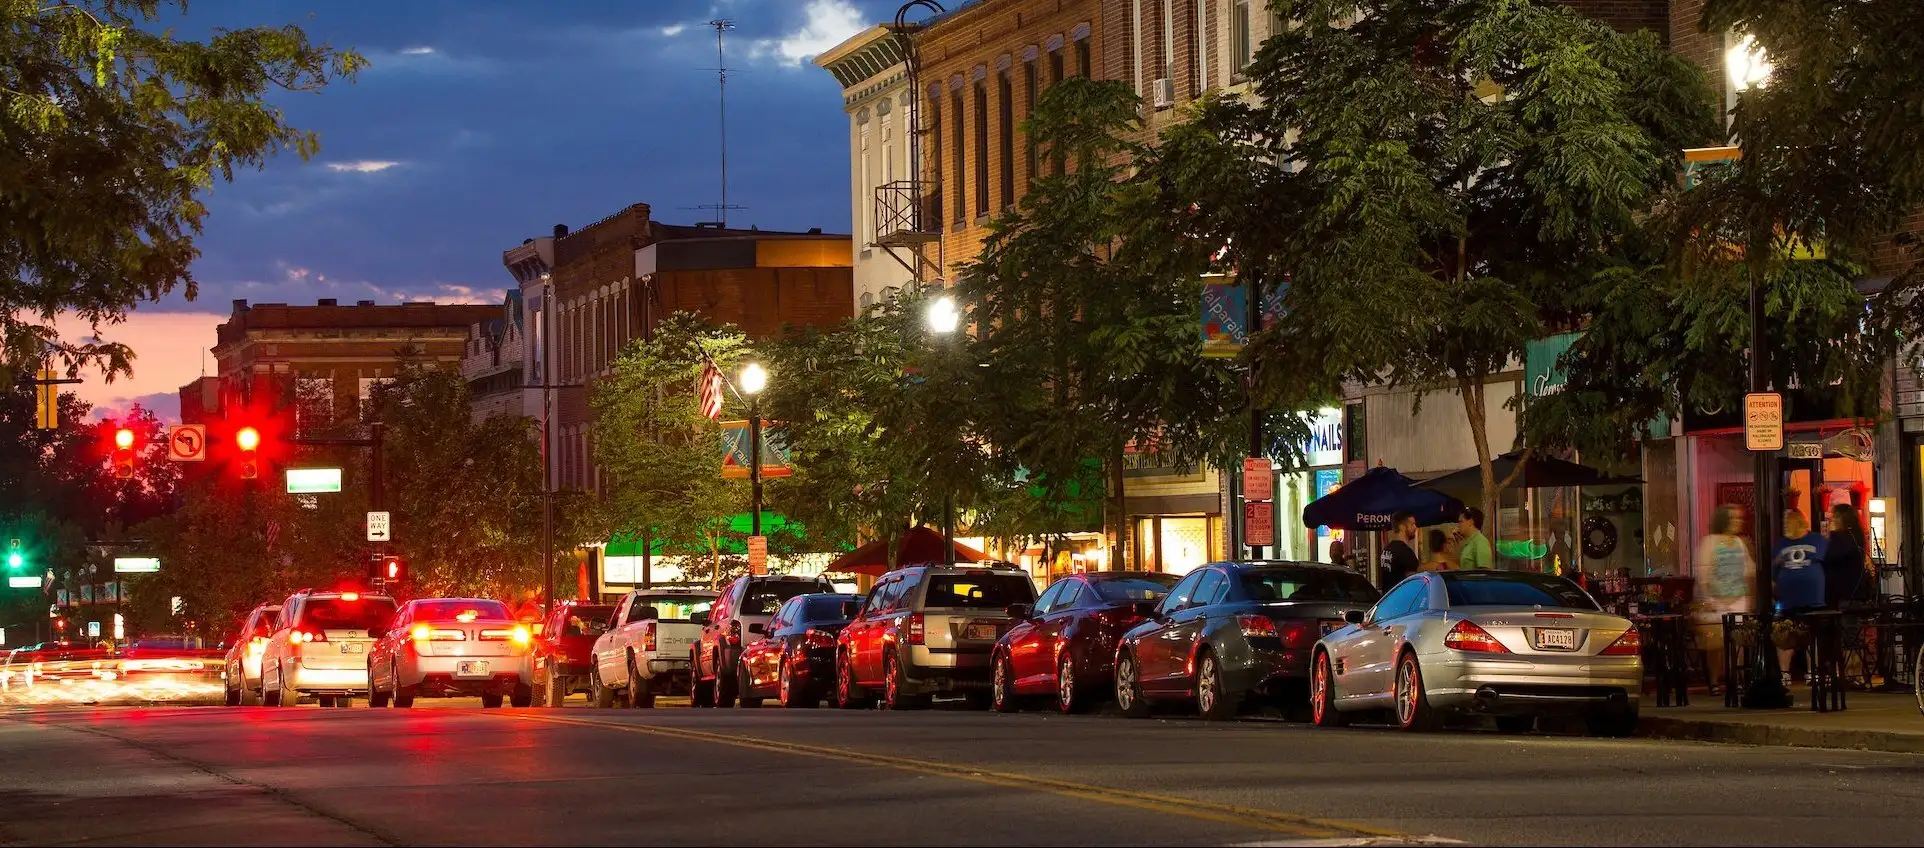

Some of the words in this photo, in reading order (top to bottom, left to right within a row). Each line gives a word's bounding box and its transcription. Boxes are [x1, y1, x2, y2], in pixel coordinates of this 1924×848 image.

[1201, 284, 1250, 347] Valparaiso
[1313, 422, 1342, 452] NAILS
[720, 428, 752, 469] Valparaiso
[1248, 506, 1254, 517] 2
[1356, 513, 1392, 523] PERON
[1547, 634, 1572, 645] AC4128
